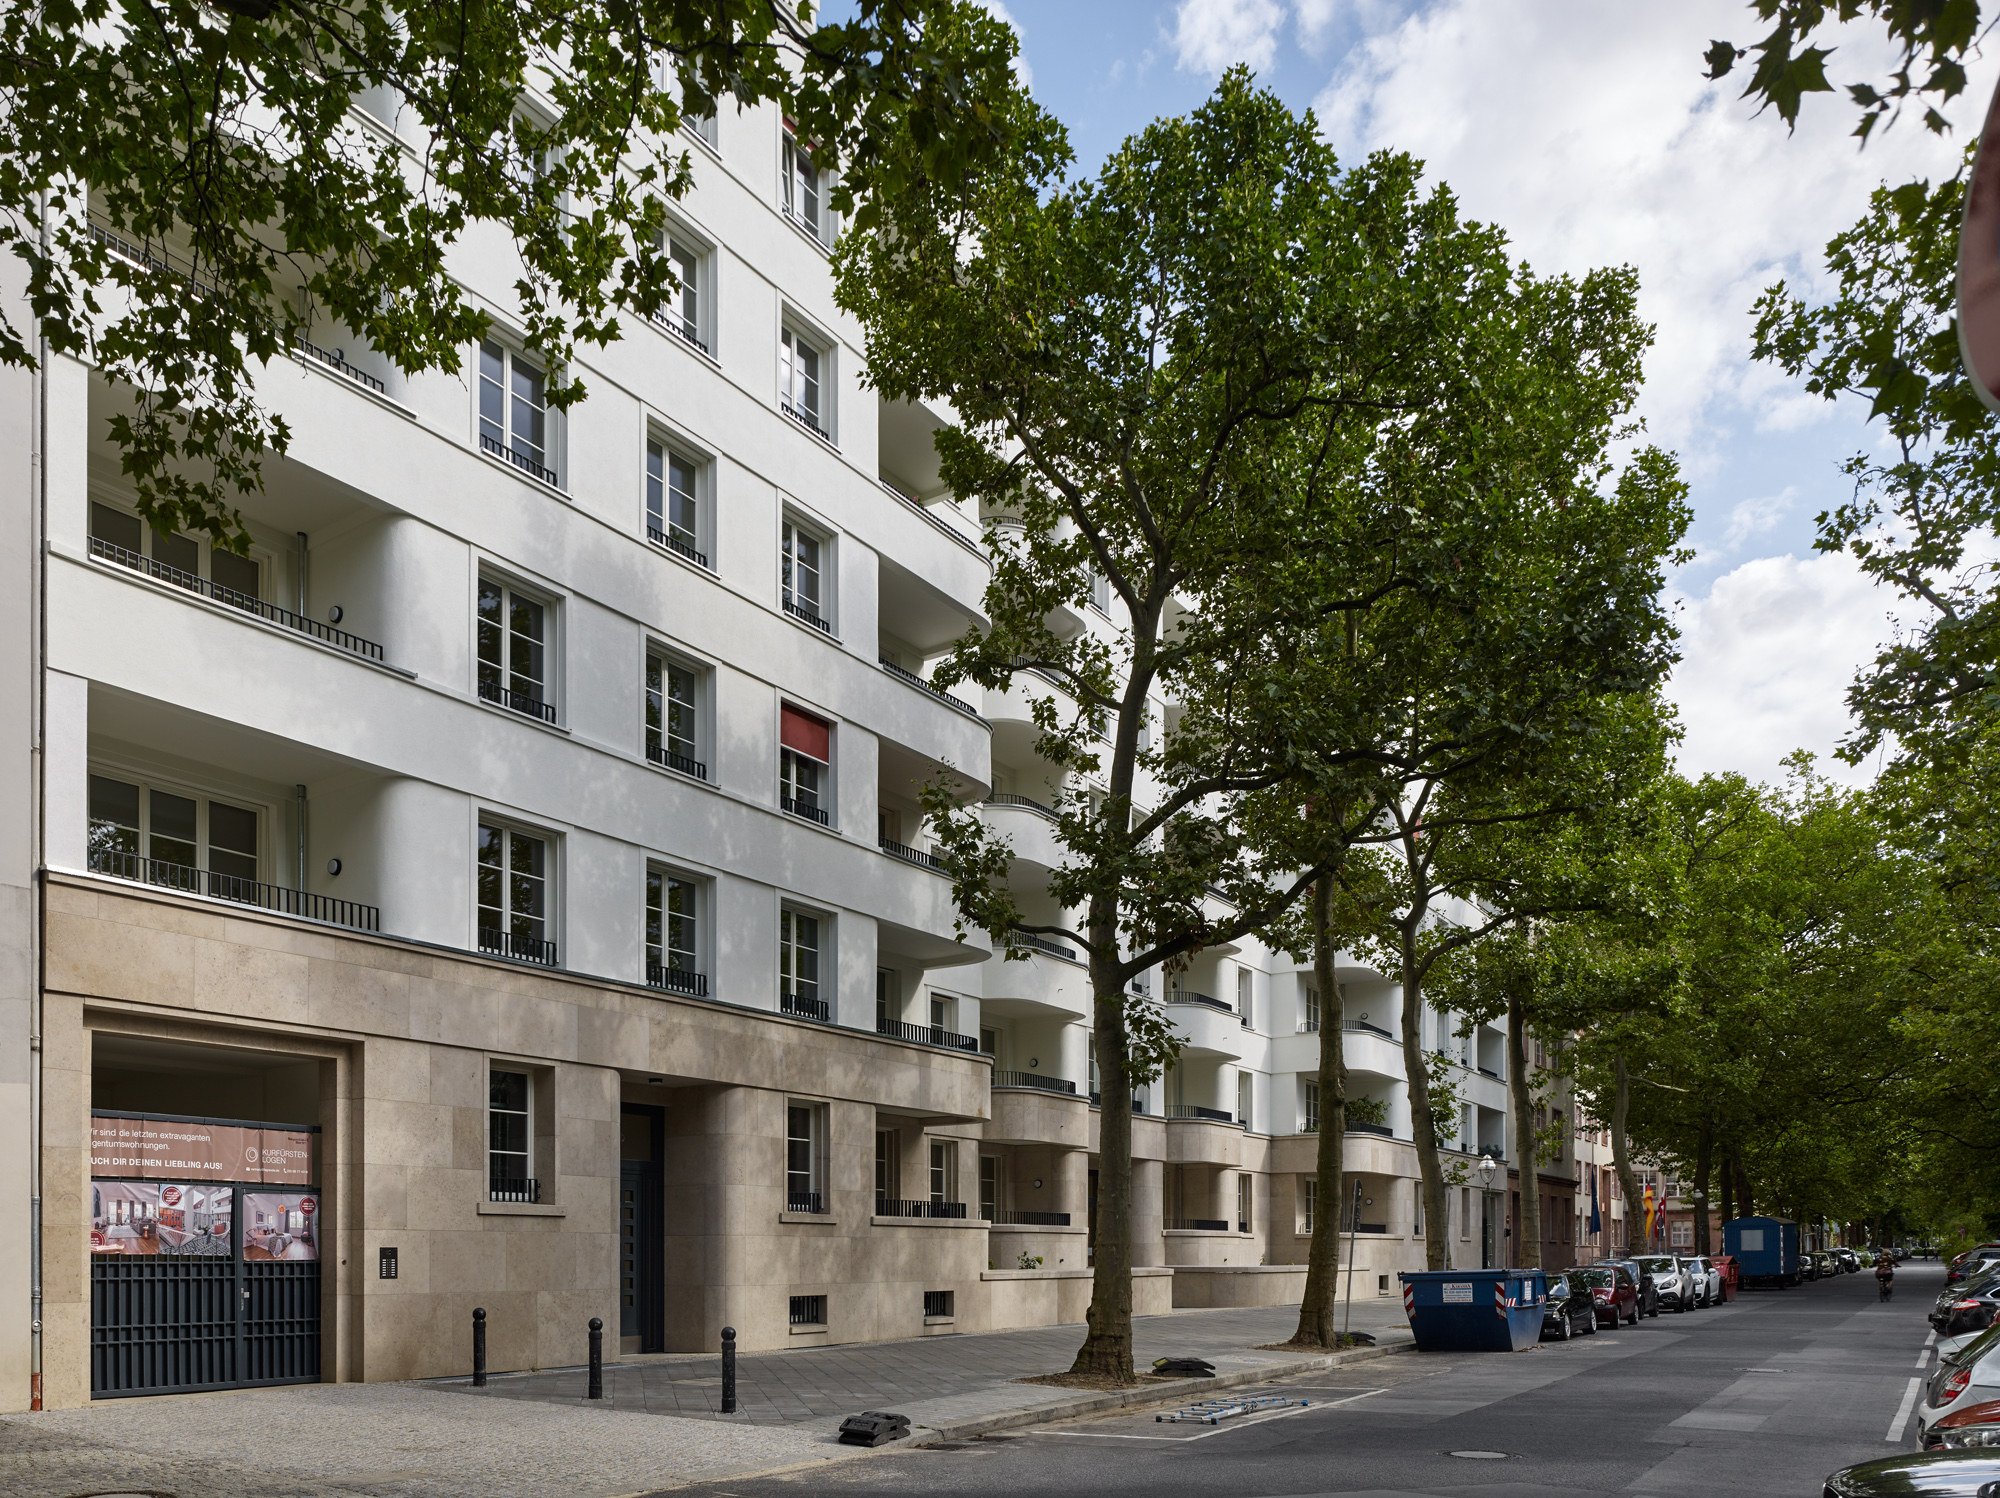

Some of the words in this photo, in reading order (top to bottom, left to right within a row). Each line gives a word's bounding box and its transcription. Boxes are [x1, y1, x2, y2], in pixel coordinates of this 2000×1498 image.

[99, 1128, 117, 1137] sind
[119, 1129, 130, 1137] die
[131, 1129, 158, 1138] letzten
[159, 1132, 210, 1142] extravaganten
[91, 1140, 170, 1151] gentumswohnungen.
[262, 1148, 309, 1158] KURFÜRSTEN-
[91, 1157, 109, 1165] UCH
[112, 1158, 127, 1166] DIR
[129, 1158, 162, 1167] DEINEN
[164, 1160, 201, 1169] LIEBLING
[203, 1162, 223, 1170] AUS!
